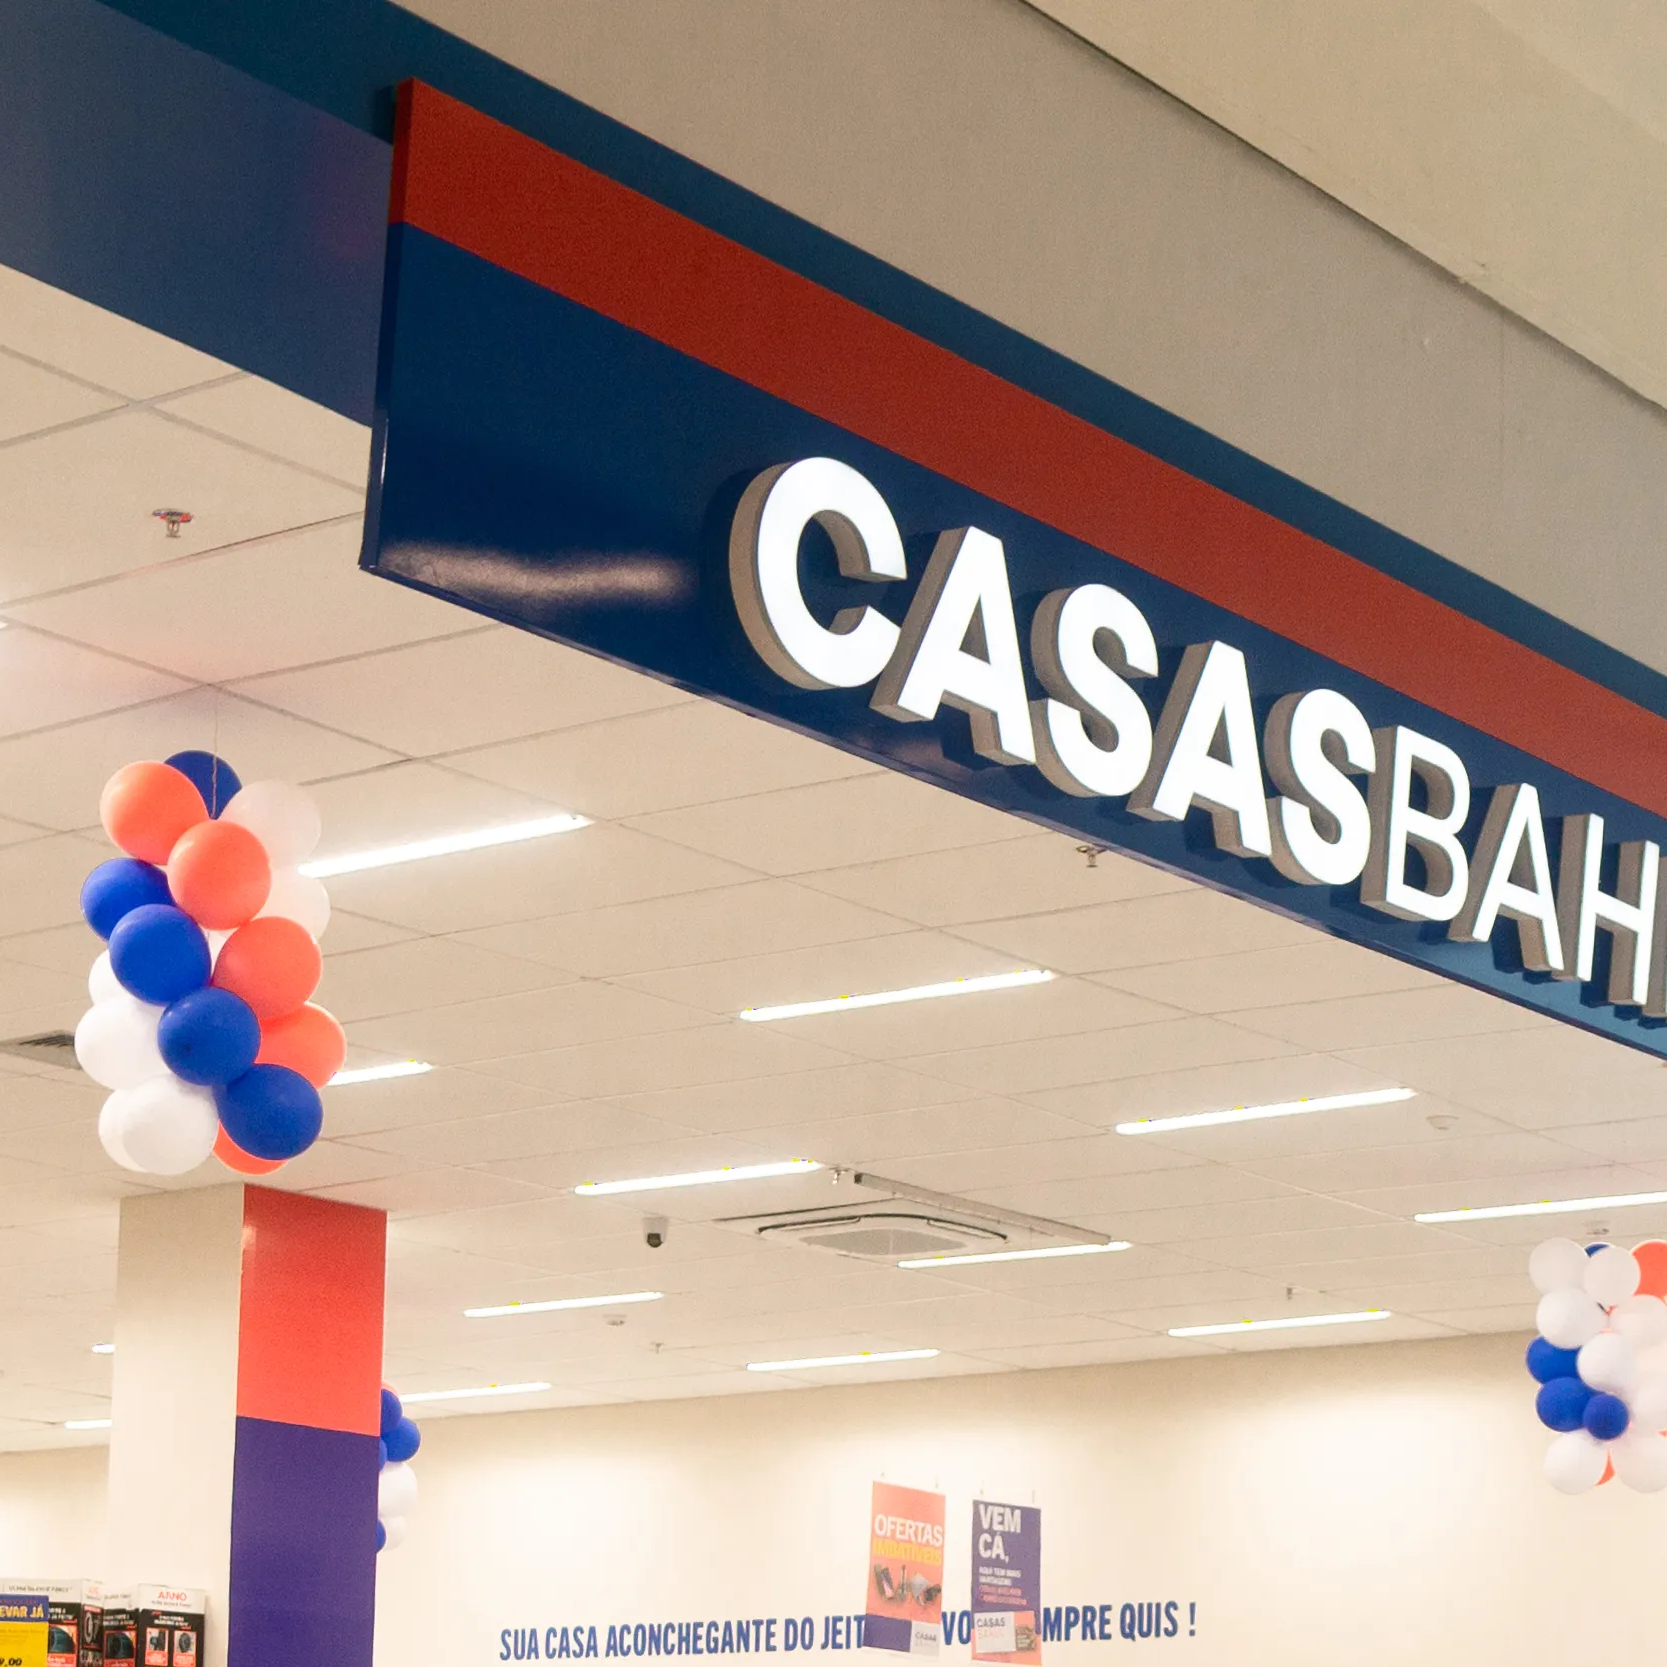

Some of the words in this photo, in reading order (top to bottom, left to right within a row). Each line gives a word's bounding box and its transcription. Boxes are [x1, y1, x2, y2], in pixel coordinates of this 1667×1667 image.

[978, 1503, 1022, 1534] VEM
[874, 1513, 944, 1548] OFERTAS
[157, 1590, 188, 1602] ARNO
[29, 1603, 44, 1619] JÁ
[976, 1617, 1006, 1628] CASAS
[499, 1628, 540, 1661] SUA
[545, 1626, 598, 1659] CASA
[605, 1618, 777, 1658] ACONCHEGANTE
[784, 1616, 815, 1652] DO
[821, 1614, 866, 1650] JEIT
[1042, 1604, 1112, 1643] MPRE
[1119, 1601, 1179, 1642] QUIS
